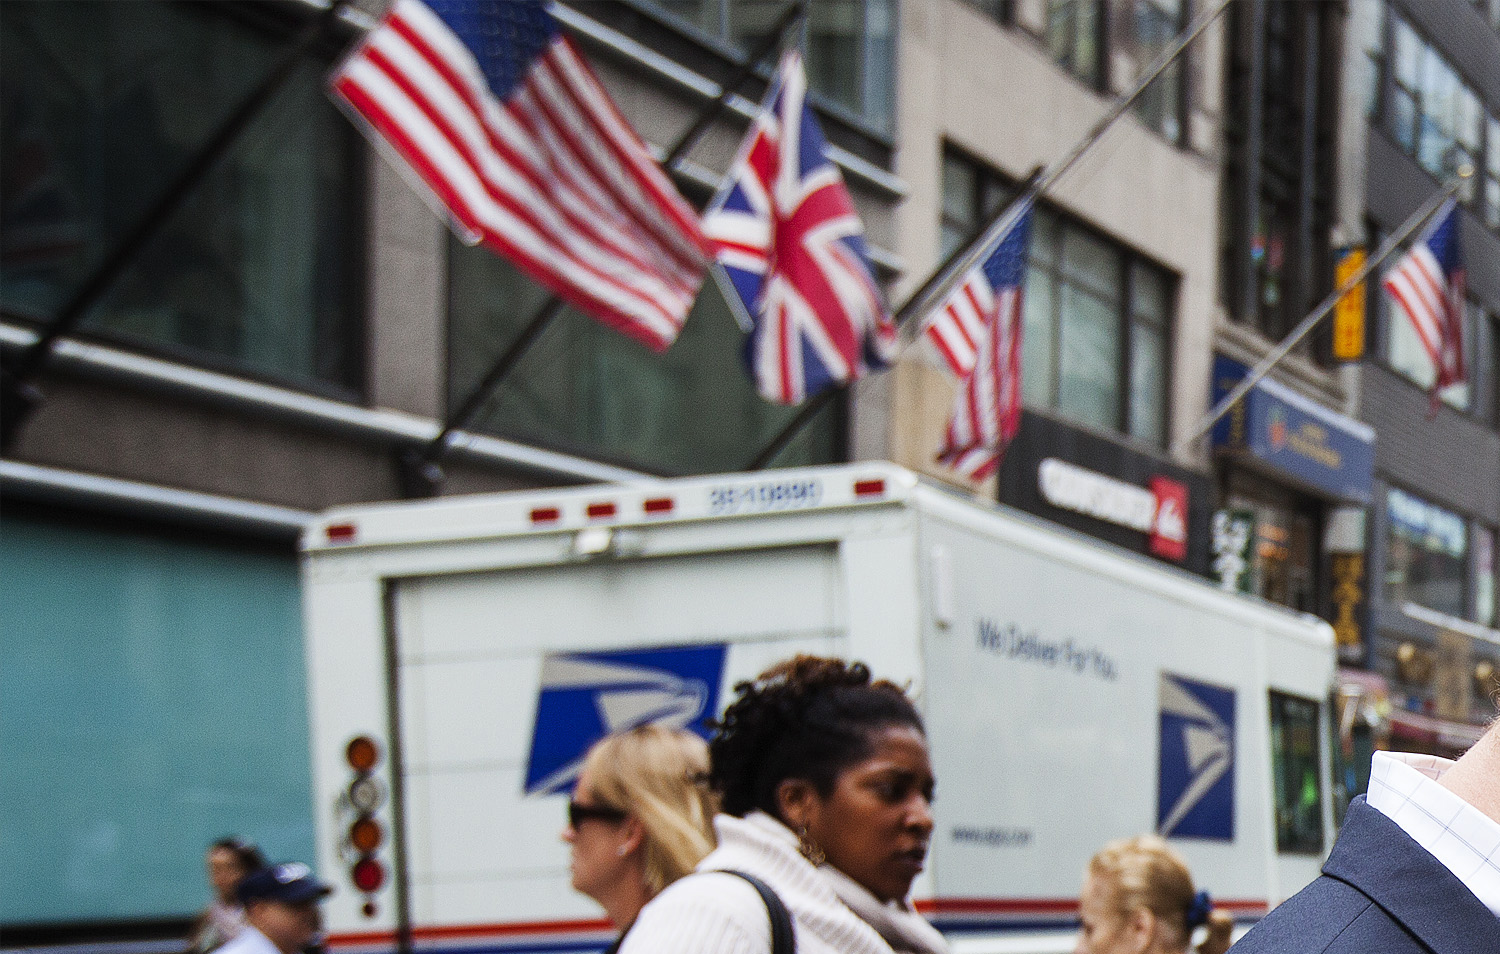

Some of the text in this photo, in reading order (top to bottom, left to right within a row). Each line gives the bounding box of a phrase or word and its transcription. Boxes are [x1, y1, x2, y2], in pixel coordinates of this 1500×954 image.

[974, 616, 1004, 654] We
[1006, 623, 1061, 667] Deliver
[1063, 638, 1087, 673] For
